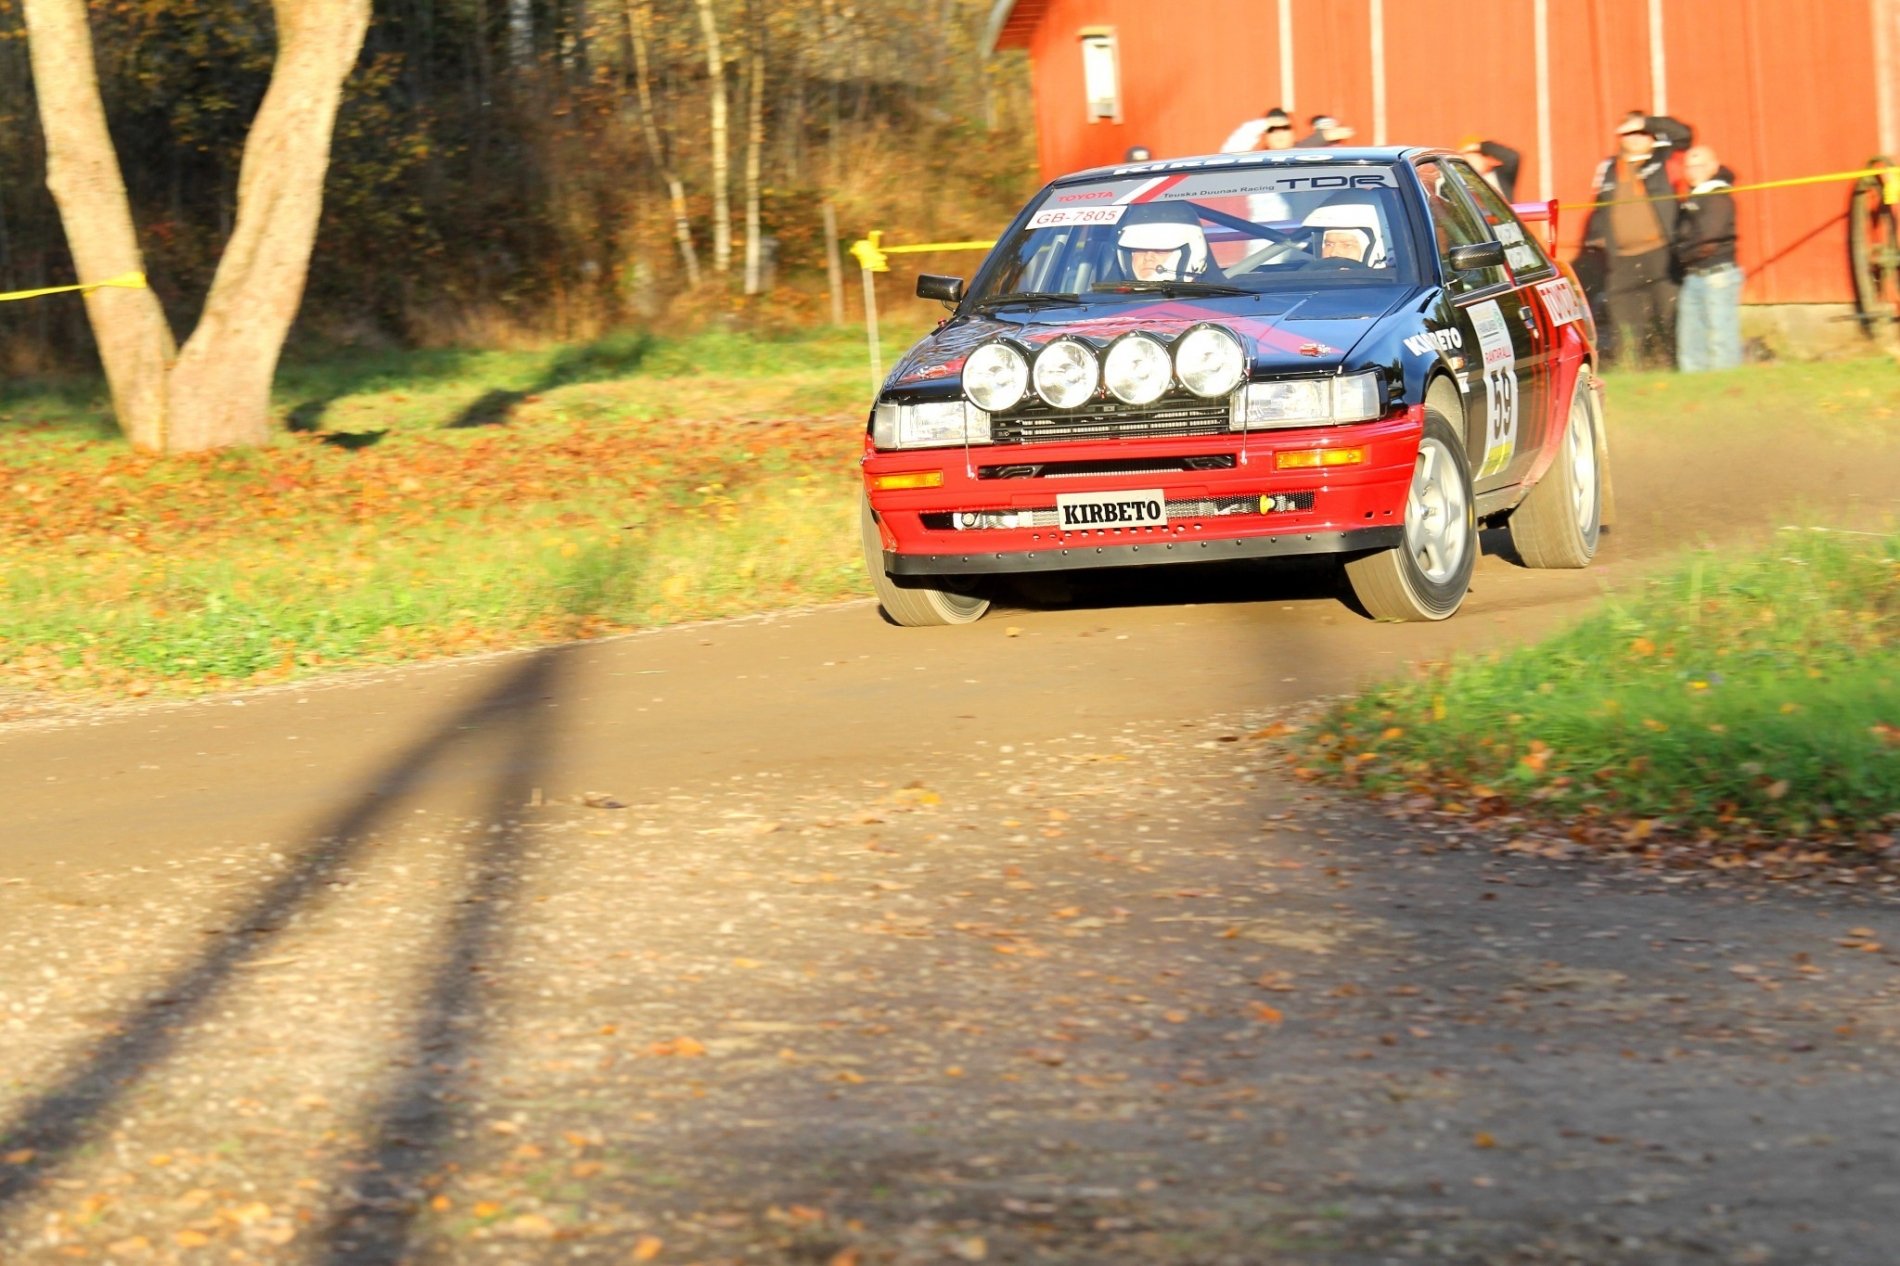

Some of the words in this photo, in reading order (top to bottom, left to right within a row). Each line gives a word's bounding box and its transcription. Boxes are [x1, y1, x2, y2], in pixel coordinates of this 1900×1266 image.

[1276, 175, 1387, 188] TDR
[1058, 191, 1113, 203] TOYOTA
[1240, 185, 1274, 195] Racing
[1037, 210, 1117, 225] GB-7805
[1492, 366, 1512, 440] 59
[1063, 500, 1161, 525] KIRBETO
